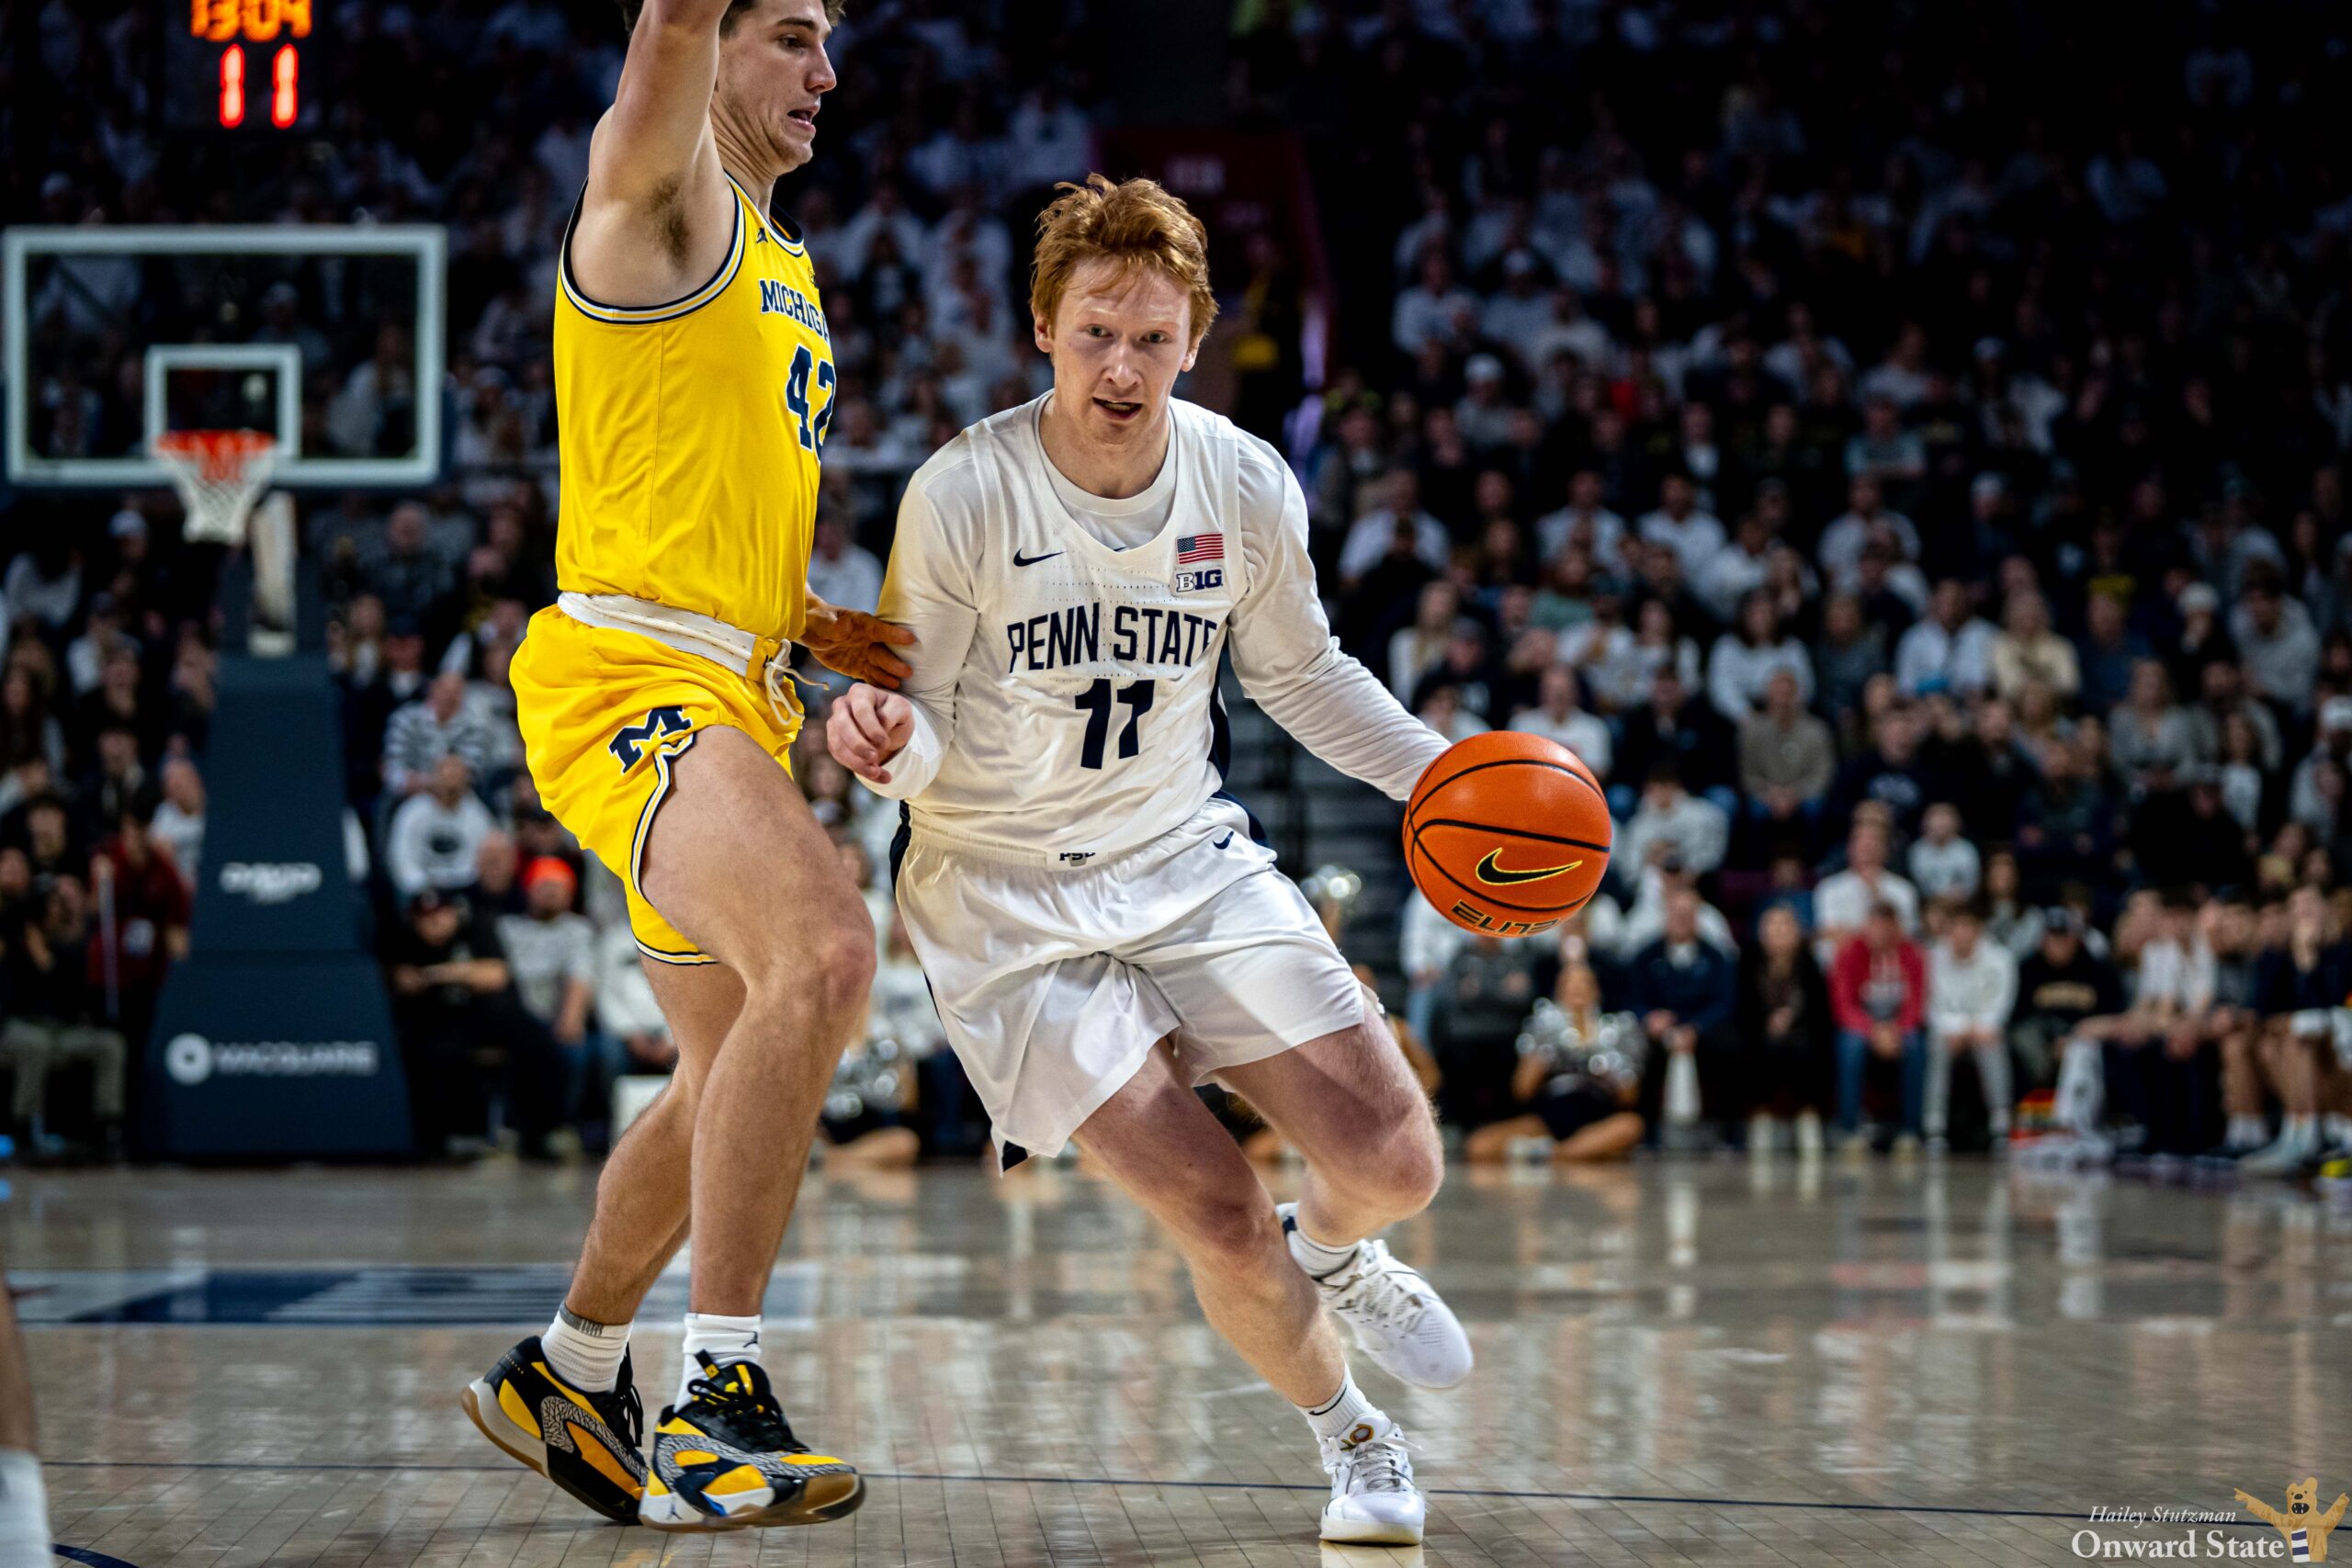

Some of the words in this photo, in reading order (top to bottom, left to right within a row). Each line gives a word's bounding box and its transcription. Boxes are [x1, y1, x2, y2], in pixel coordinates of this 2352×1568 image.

[219, 43, 300, 130] 11
[786, 343, 836, 464] 42
[1007, 602, 1100, 674] PENN
[608, 704, 693, 773] M
[1074, 678, 1156, 770] 11
